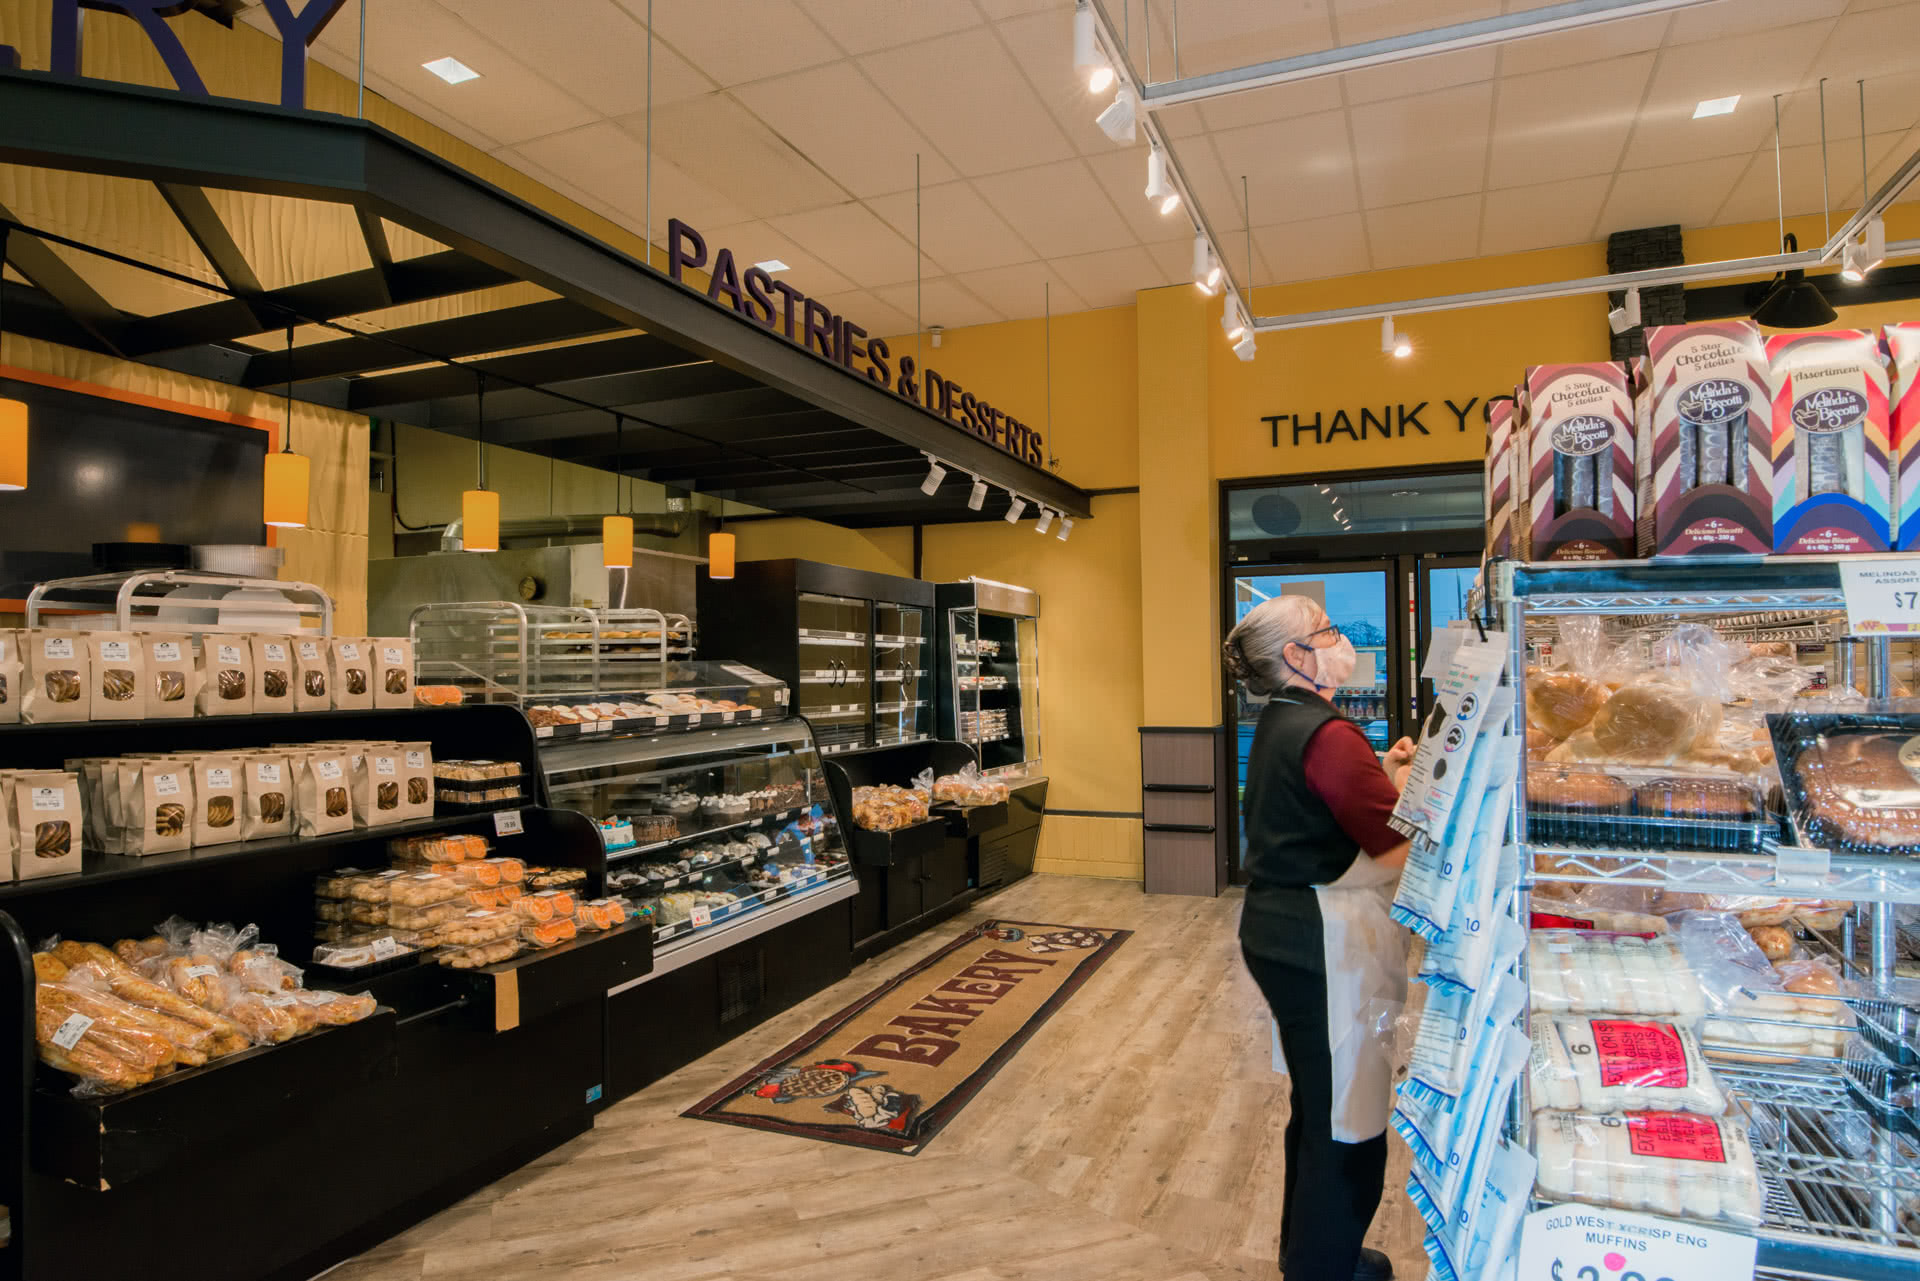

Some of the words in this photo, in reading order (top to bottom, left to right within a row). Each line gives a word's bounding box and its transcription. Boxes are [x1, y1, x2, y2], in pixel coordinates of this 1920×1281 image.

[0, 0, 345, 110] RY
[668, 218, 891, 389] PASTRIES
[898, 356, 920, 404] &
[926, 369, 1043, 468] DESSERTS
[1701, 343, 1722, 351] Star
[1676, 346, 1744, 366] Chocolate
[1695, 363, 1702, 371] 5
[1552, 385, 1611, 403] Chocolate
[1689, 381, 1739, 402] Melinda's
[1805, 390, 1856, 412] Melinda's
[1704, 395, 1743, 418] Biscotti
[1820, 405, 1859, 427] Biscotti
[1261, 402, 1430, 447] THANK
[1562, 416, 1606, 436] Melinda's
[1465, 916, 1480, 932] 10
[847, 949, 1058, 1067] BAKERY
[1598, 1022, 1619, 1049] CRISP
[1571, 1044, 1592, 1055] 6
[1622, 1032, 1639, 1071] ENGLISH
[1546, 1216, 1572, 1231] GOLD
[1575, 1216, 1614, 1230] WEST
[1676, 1233, 1708, 1248] ENG
[1585, 1232, 1647, 1251] MUFFINS
